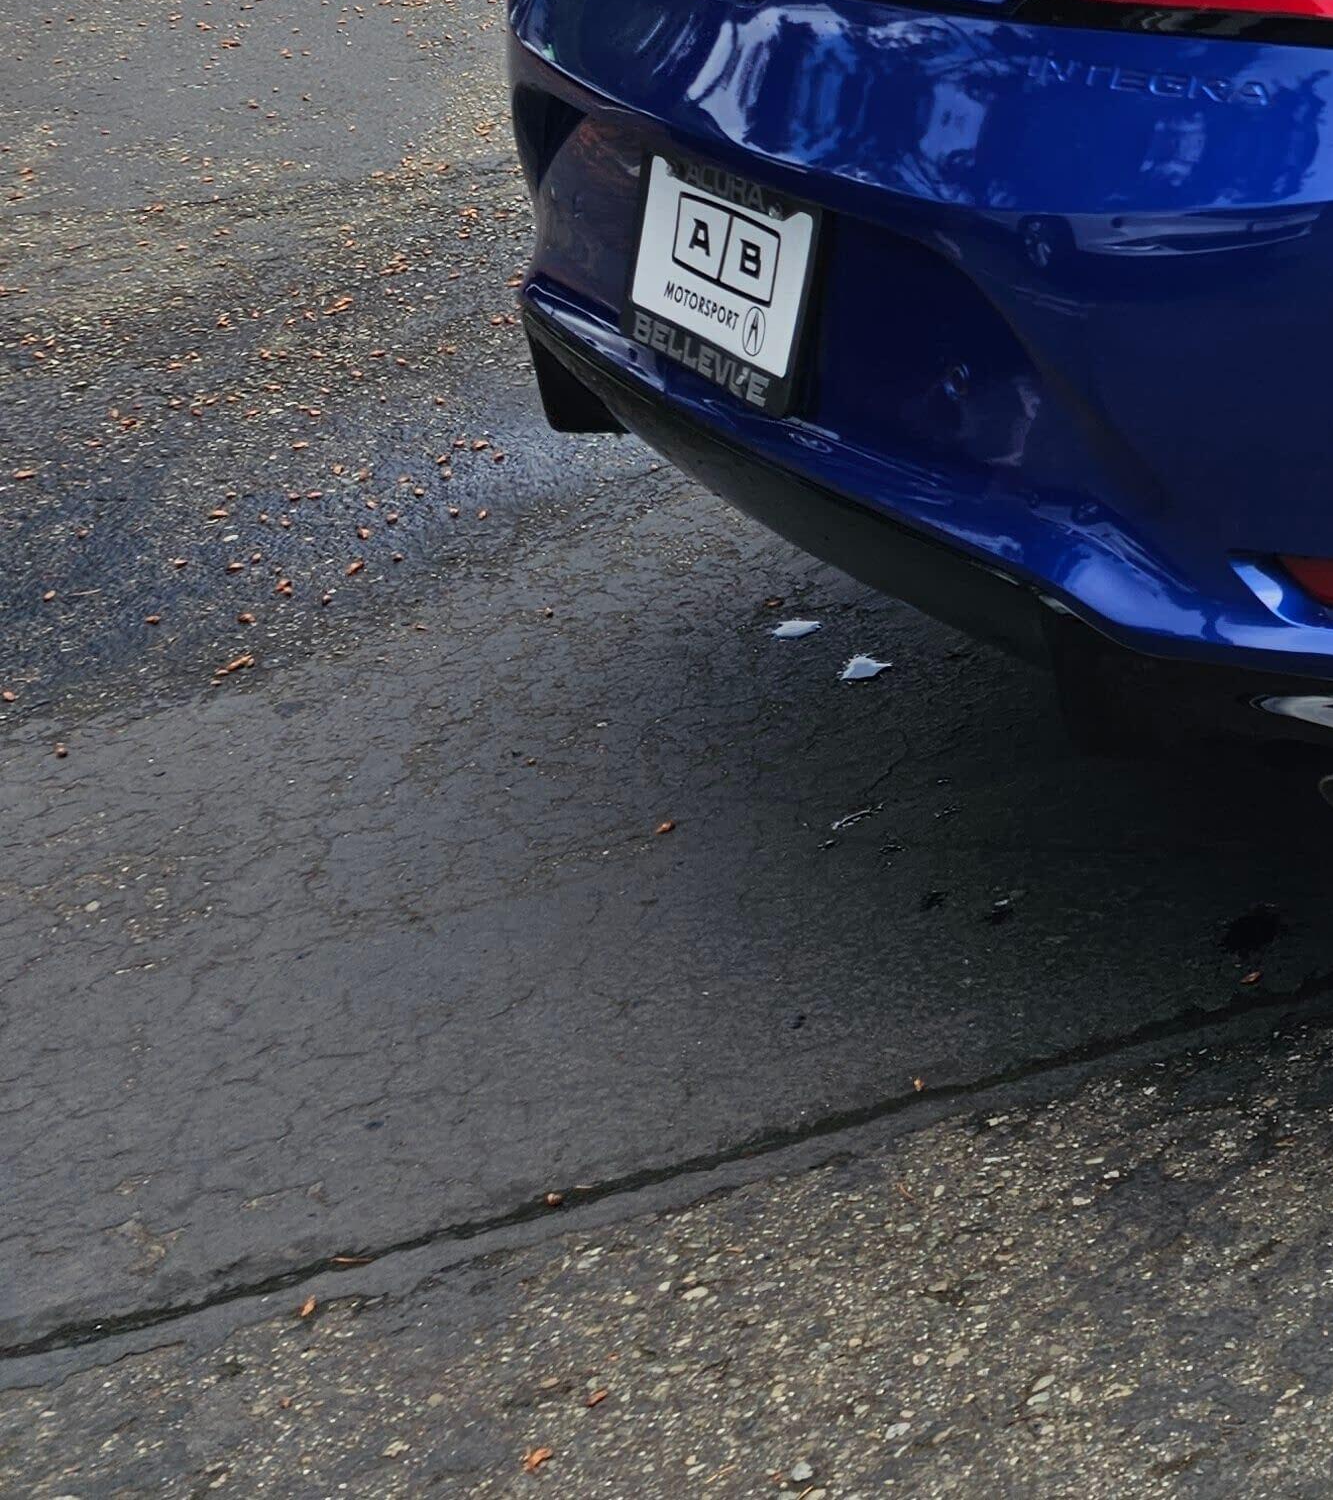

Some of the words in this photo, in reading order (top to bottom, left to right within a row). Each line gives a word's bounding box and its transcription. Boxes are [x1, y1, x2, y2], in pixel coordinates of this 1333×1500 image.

[1027, 55, 1269, 106] INTEGRA
[682, 164, 766, 212] ACURA
[688, 217, 712, 257] A
[739, 237, 762, 280] B
[663, 280, 740, 331] MOTORSPORT
[632, 310, 771, 408] BELLEVUE
